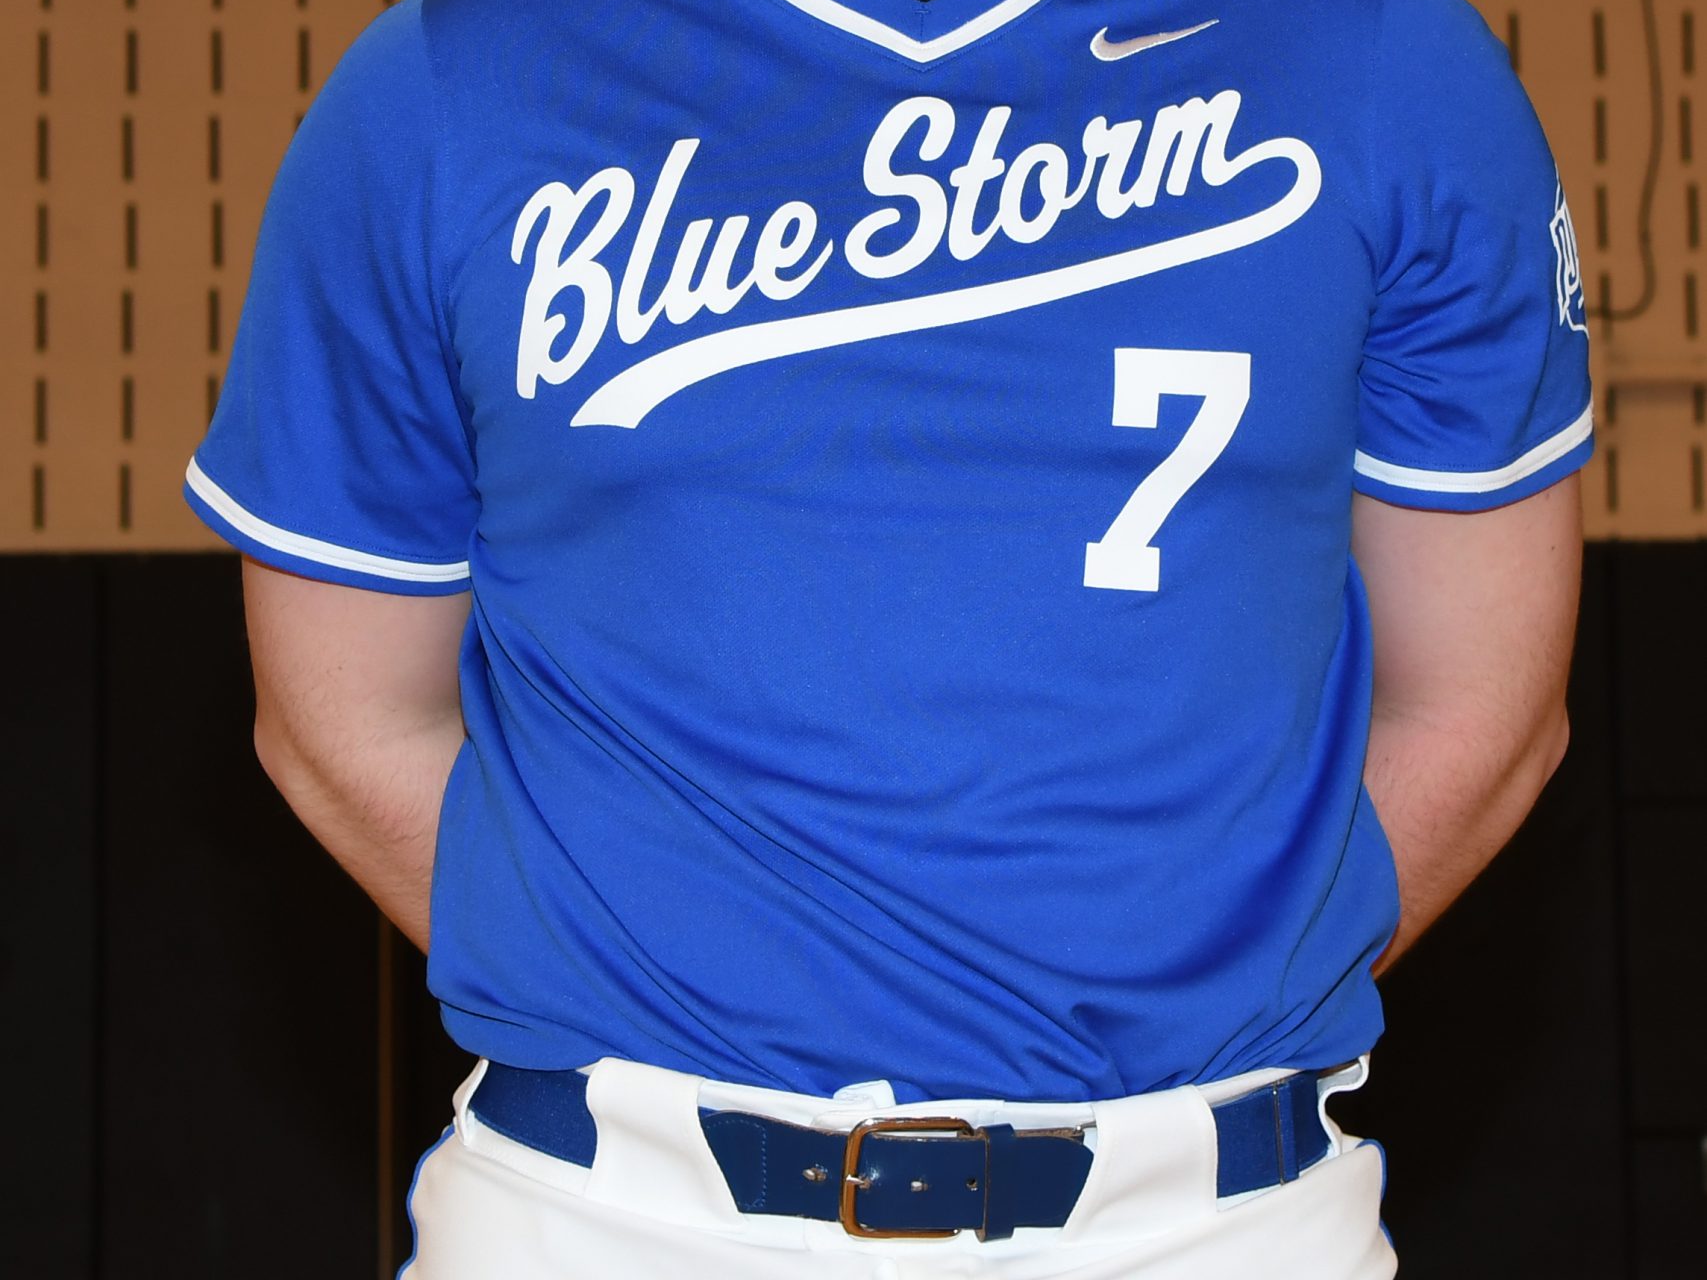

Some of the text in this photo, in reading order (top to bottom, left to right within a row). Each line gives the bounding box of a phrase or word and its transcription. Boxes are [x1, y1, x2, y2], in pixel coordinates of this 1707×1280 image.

[511, 89, 1244, 399] Blue Storm
[1083, 347, 1252, 592] 7
